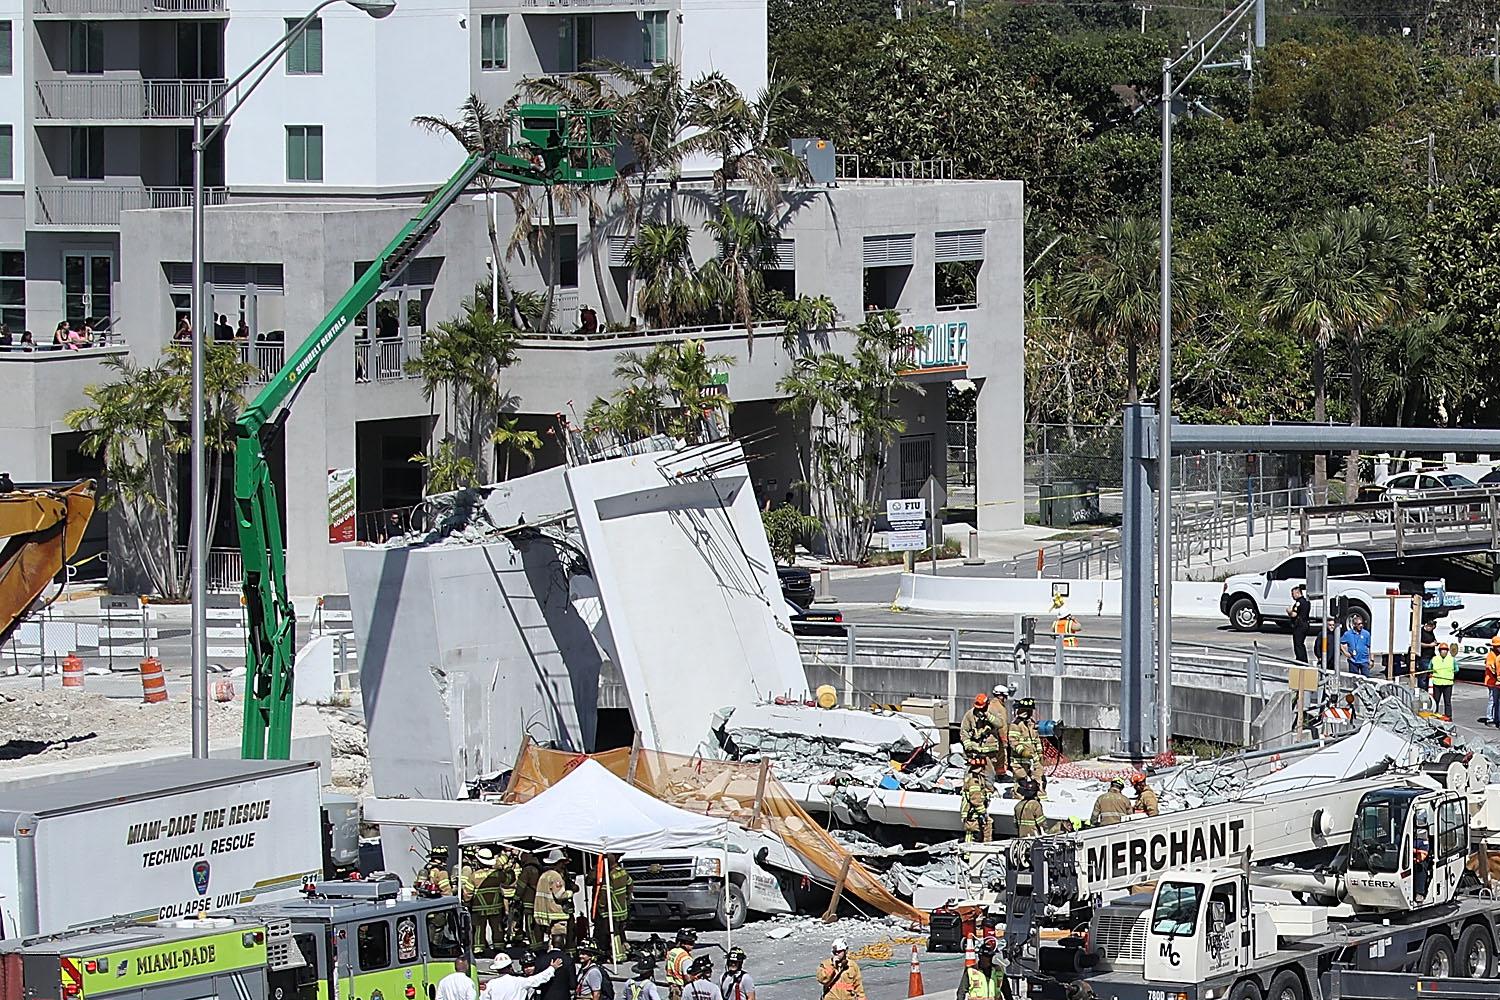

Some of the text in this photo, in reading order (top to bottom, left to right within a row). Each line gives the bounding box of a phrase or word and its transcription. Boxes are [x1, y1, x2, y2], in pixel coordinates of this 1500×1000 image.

[296, 315, 346, 375] SUNBELT RENTALS
[905, 502, 920, 510] FIU
[333, 517, 344, 528] NOW
[127, 800, 271, 845] MIAMI-DADE FIRE RESCUE
[142, 832, 255, 868] TECHNICAL RESCUE
[1087, 819, 1244, 883] MERCHANT
[1361, 879, 1396, 889] TEREX
[159, 892, 241, 920] COLLAPSE UNIT
[136, 944, 216, 976] MIAMI-DADE
